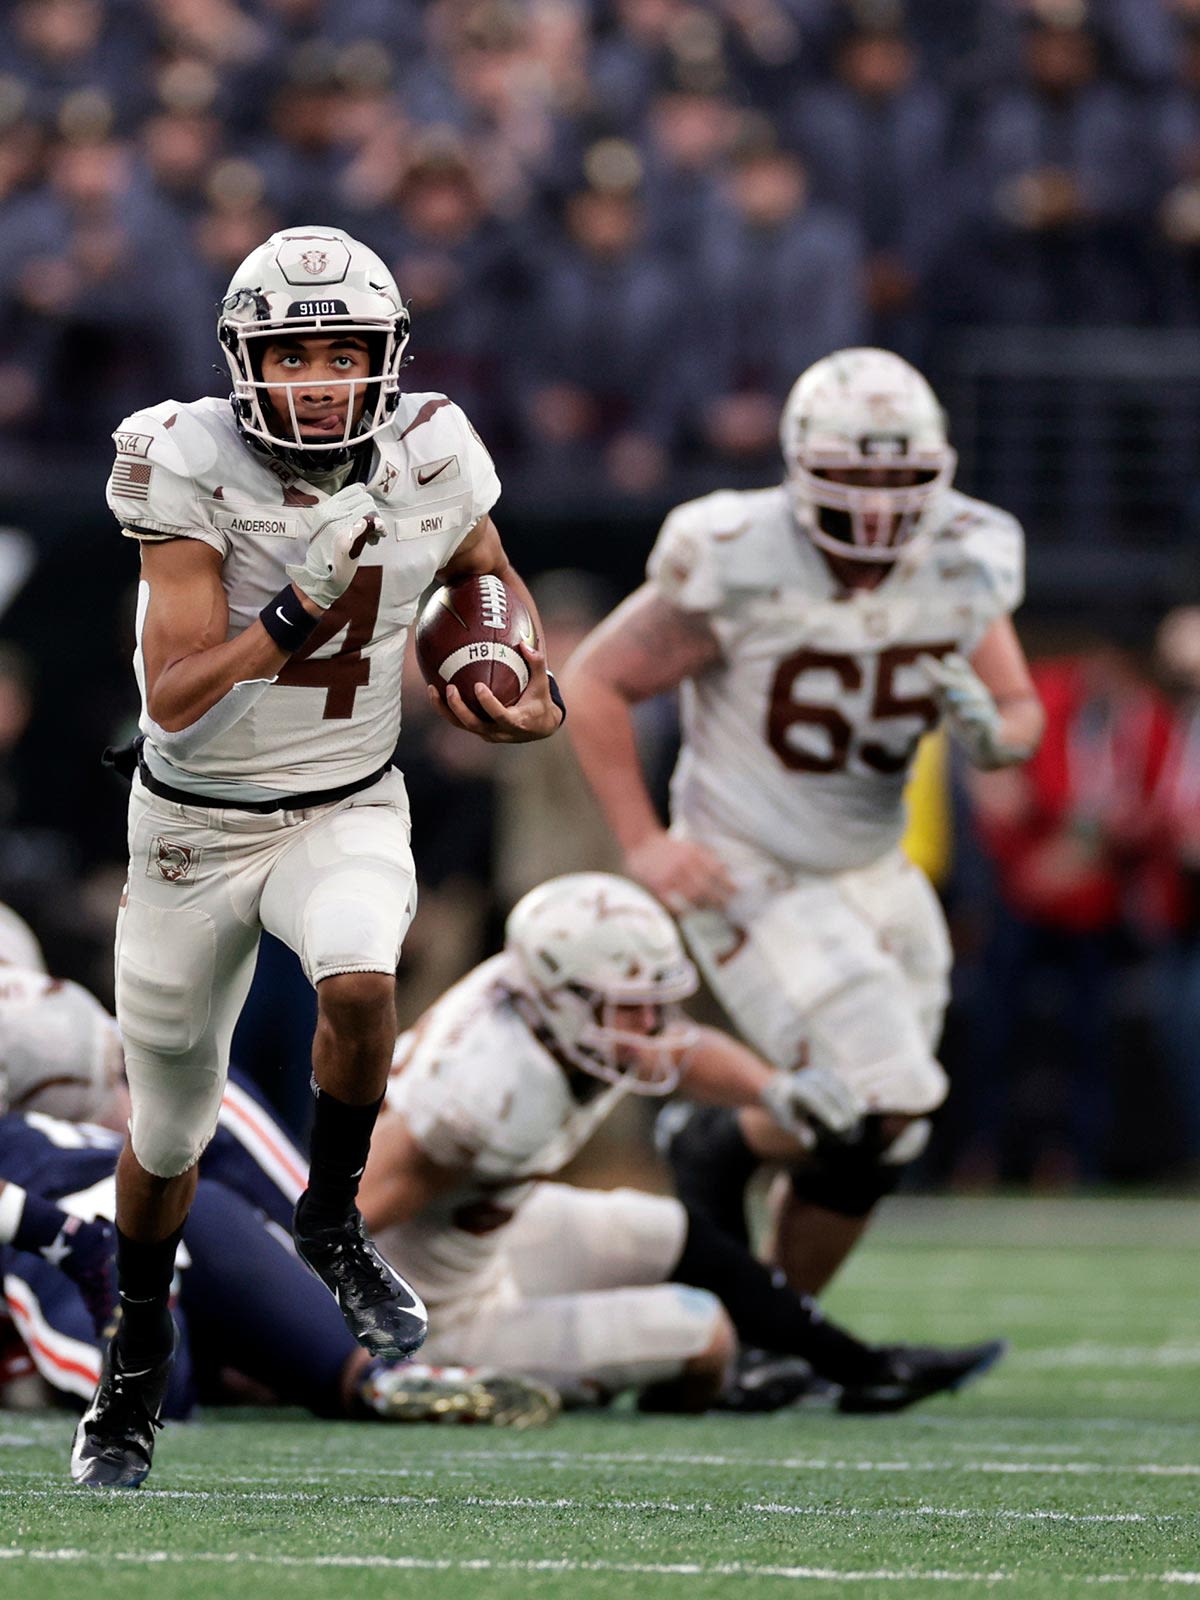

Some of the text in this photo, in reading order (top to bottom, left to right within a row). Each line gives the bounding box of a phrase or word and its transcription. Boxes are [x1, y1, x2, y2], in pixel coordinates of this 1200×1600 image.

[300, 302, 336, 315] 91101
[231, 518, 286, 534] ANDERSON
[420, 516, 444, 533] ARMY
[270, 565, 383, 719] 4
[767, 641, 956, 775] 65
